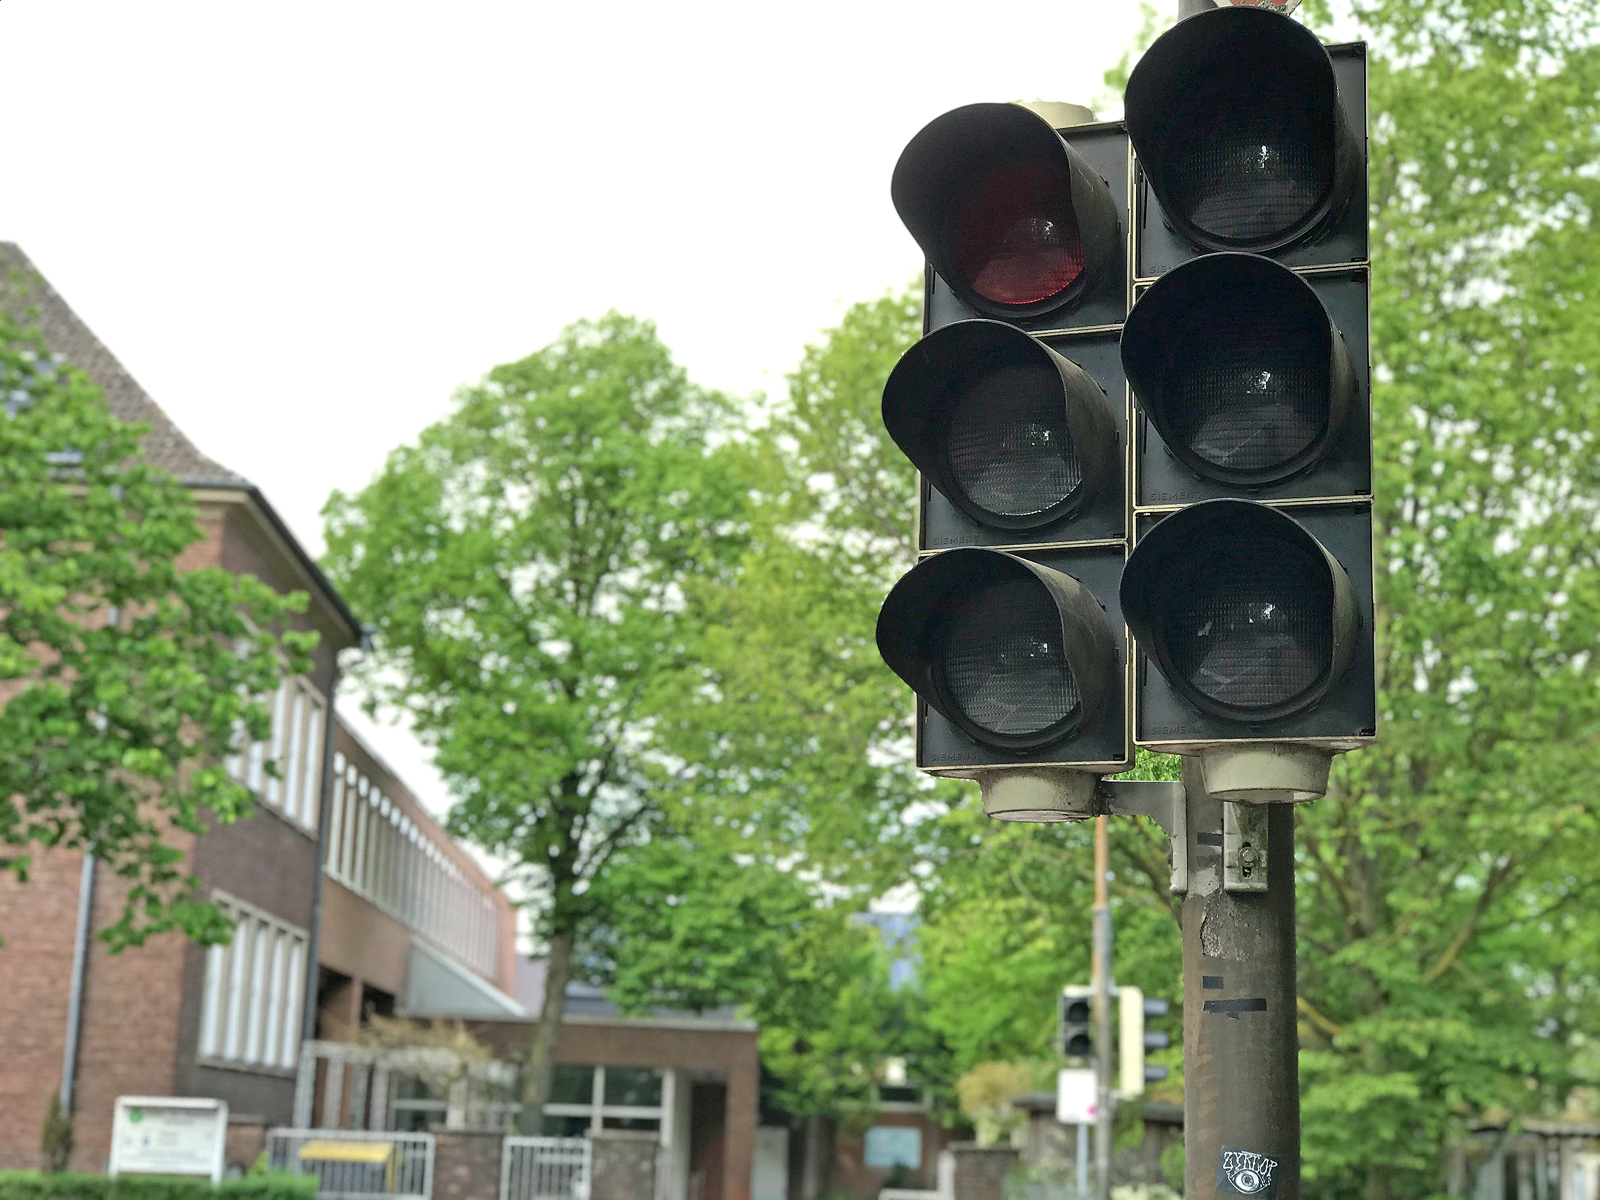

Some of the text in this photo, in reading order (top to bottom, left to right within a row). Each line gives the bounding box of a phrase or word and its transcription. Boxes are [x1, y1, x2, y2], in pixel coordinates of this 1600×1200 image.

[933, 535, 979, 546] SIEMENS
[930, 752, 977, 762] SIEMENS
[1223, 1150, 1278, 1177] ZYKLOP
